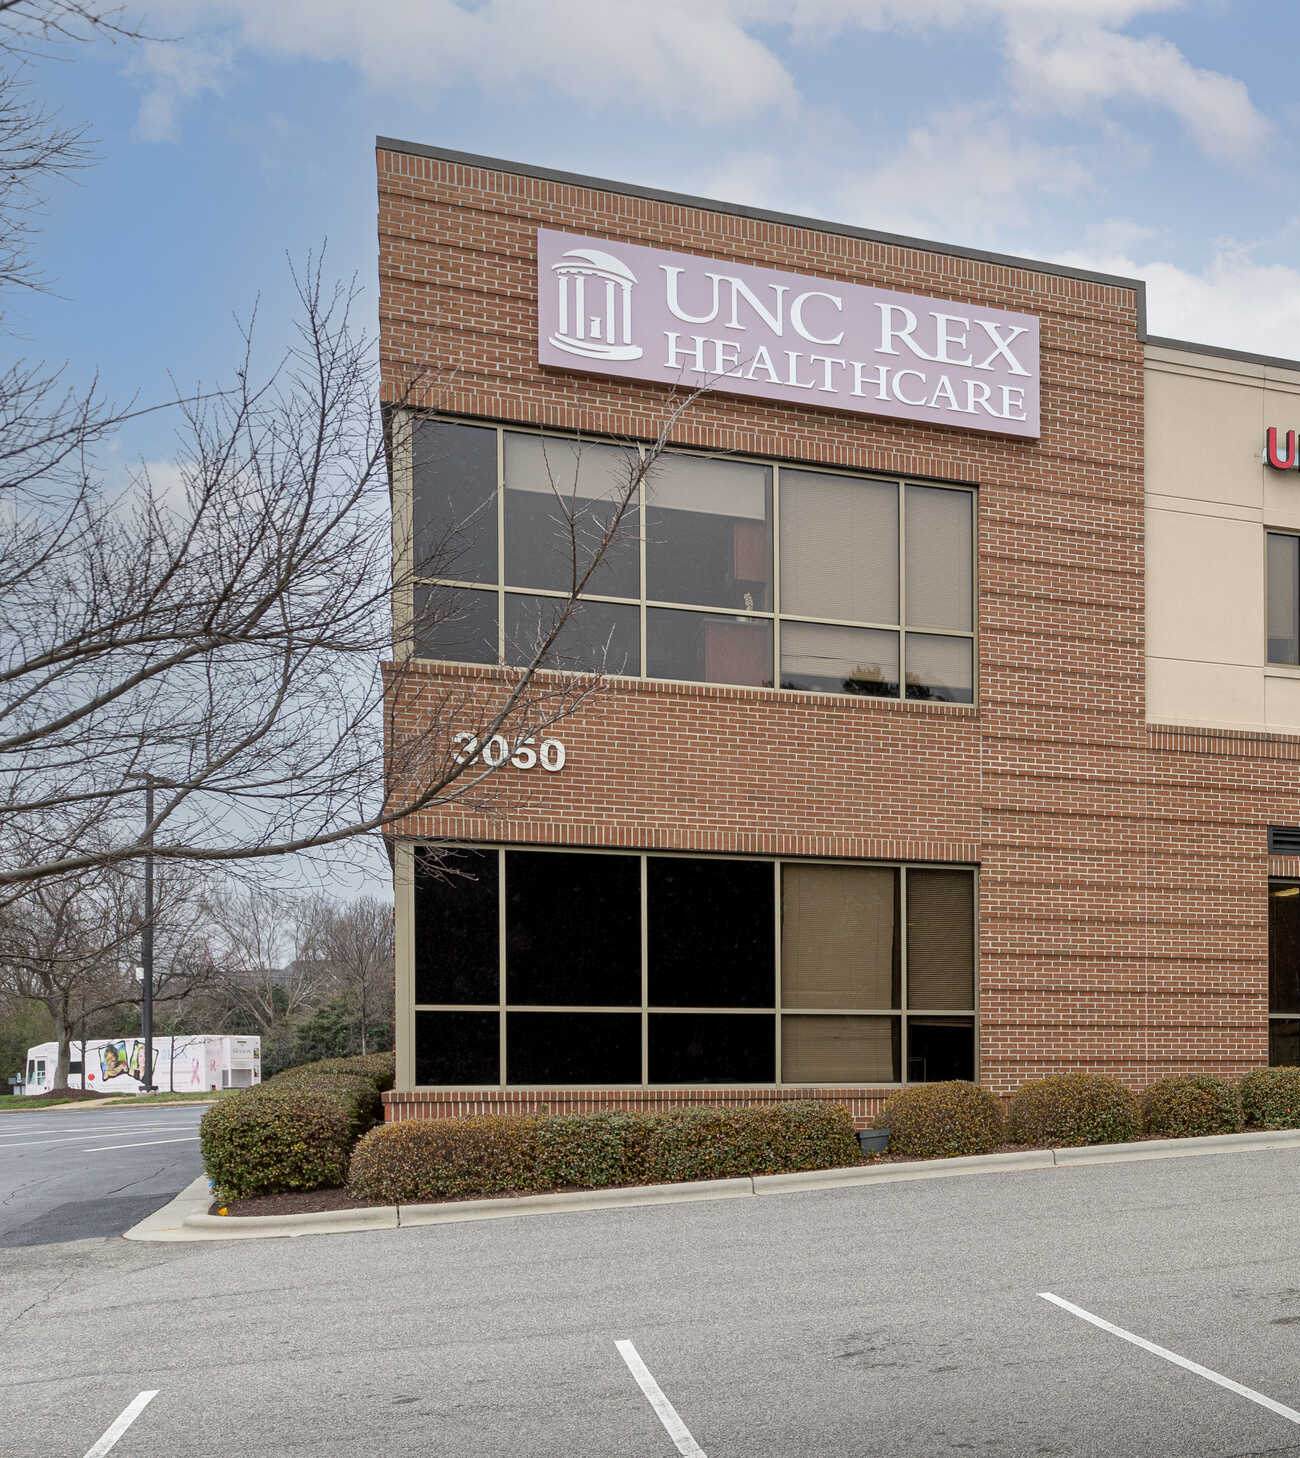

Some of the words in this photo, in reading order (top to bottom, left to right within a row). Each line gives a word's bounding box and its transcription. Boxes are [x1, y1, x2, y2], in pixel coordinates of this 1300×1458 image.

[660, 265, 844, 345] UNC
[874, 303, 1031, 376] REX
[663, 331, 1027, 421] HEALTHCARE
[453, 732, 566, 772] 3050
